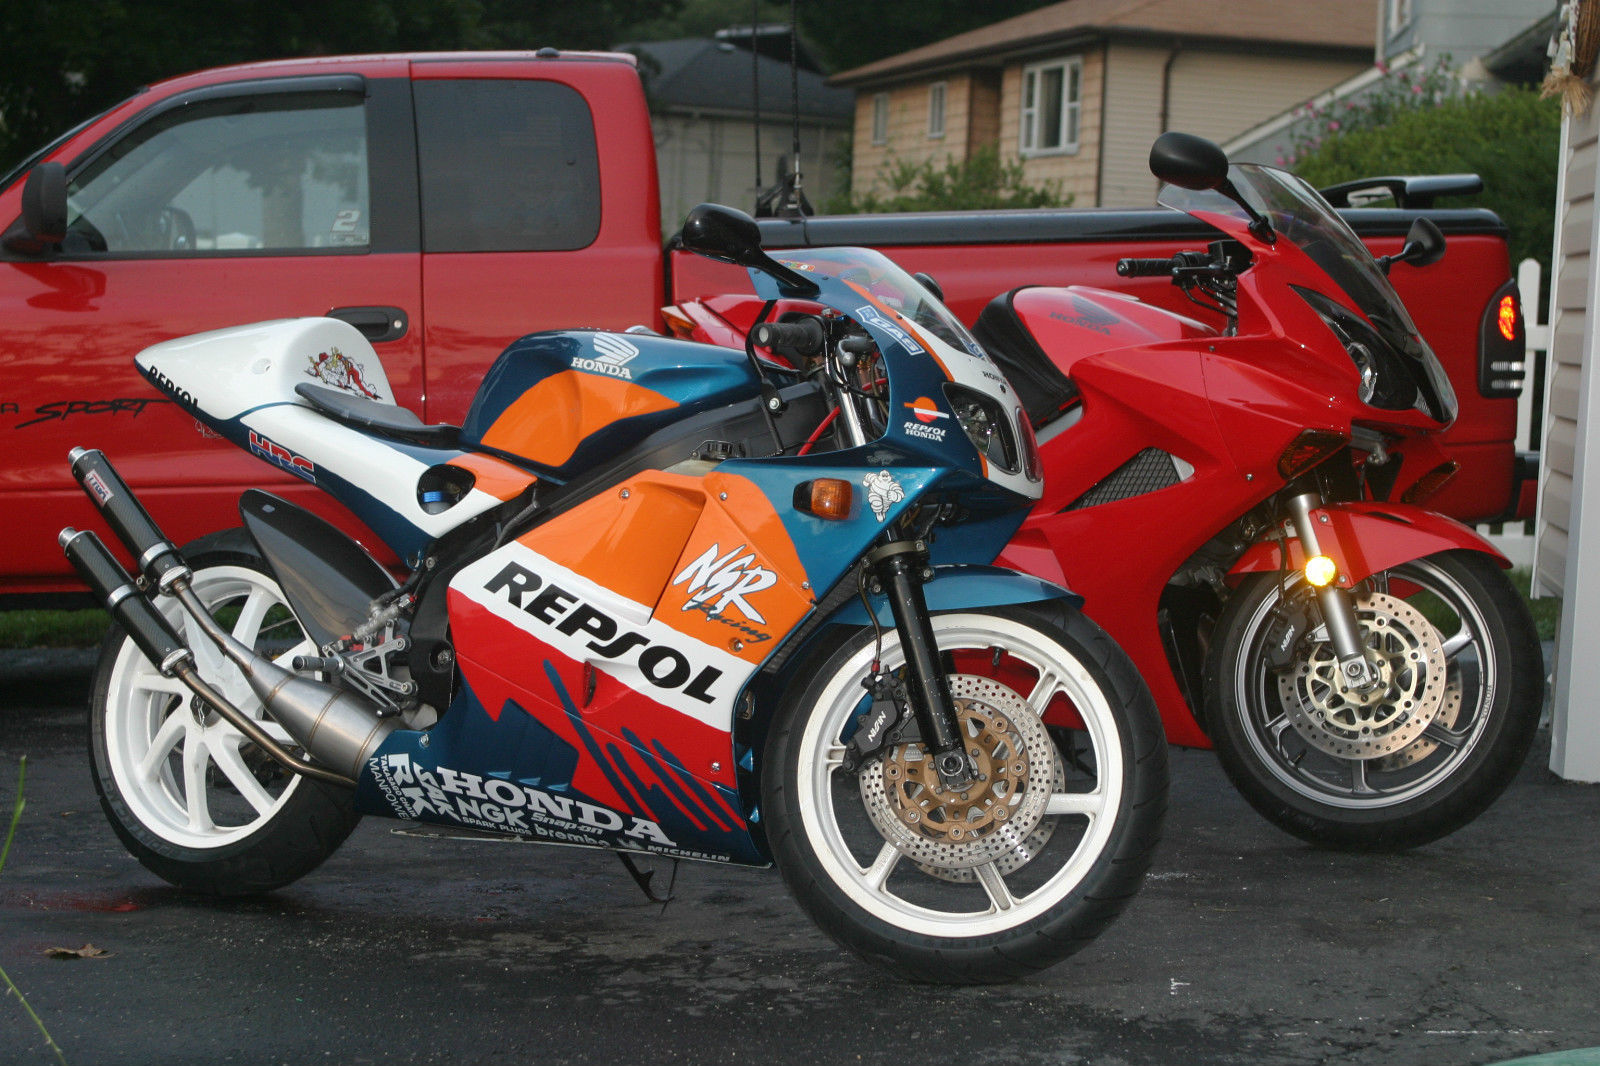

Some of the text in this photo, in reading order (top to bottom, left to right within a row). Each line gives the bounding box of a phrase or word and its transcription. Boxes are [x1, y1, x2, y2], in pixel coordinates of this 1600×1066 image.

[1049, 311, 1111, 336] HONDA
[570, 356, 632, 379] HONDA
[15, 398, 173, 429] SPORT
[903, 421, 946, 437] REPSOL
[905, 428, 943, 443] HONDA
[249, 429, 317, 485] HRC
[672, 542, 778, 626] NSR
[483, 560, 723, 704] REPSOL
[388, 753, 438, 816] RK
[437, 765, 677, 847] HONDA
[455, 795, 530, 830] NGK
[462, 816, 497, 830] SPARK
[531, 811, 604, 836] Snap-on
[533, 823, 612, 847] brembo
[648, 845, 731, 862] MICHELIN
